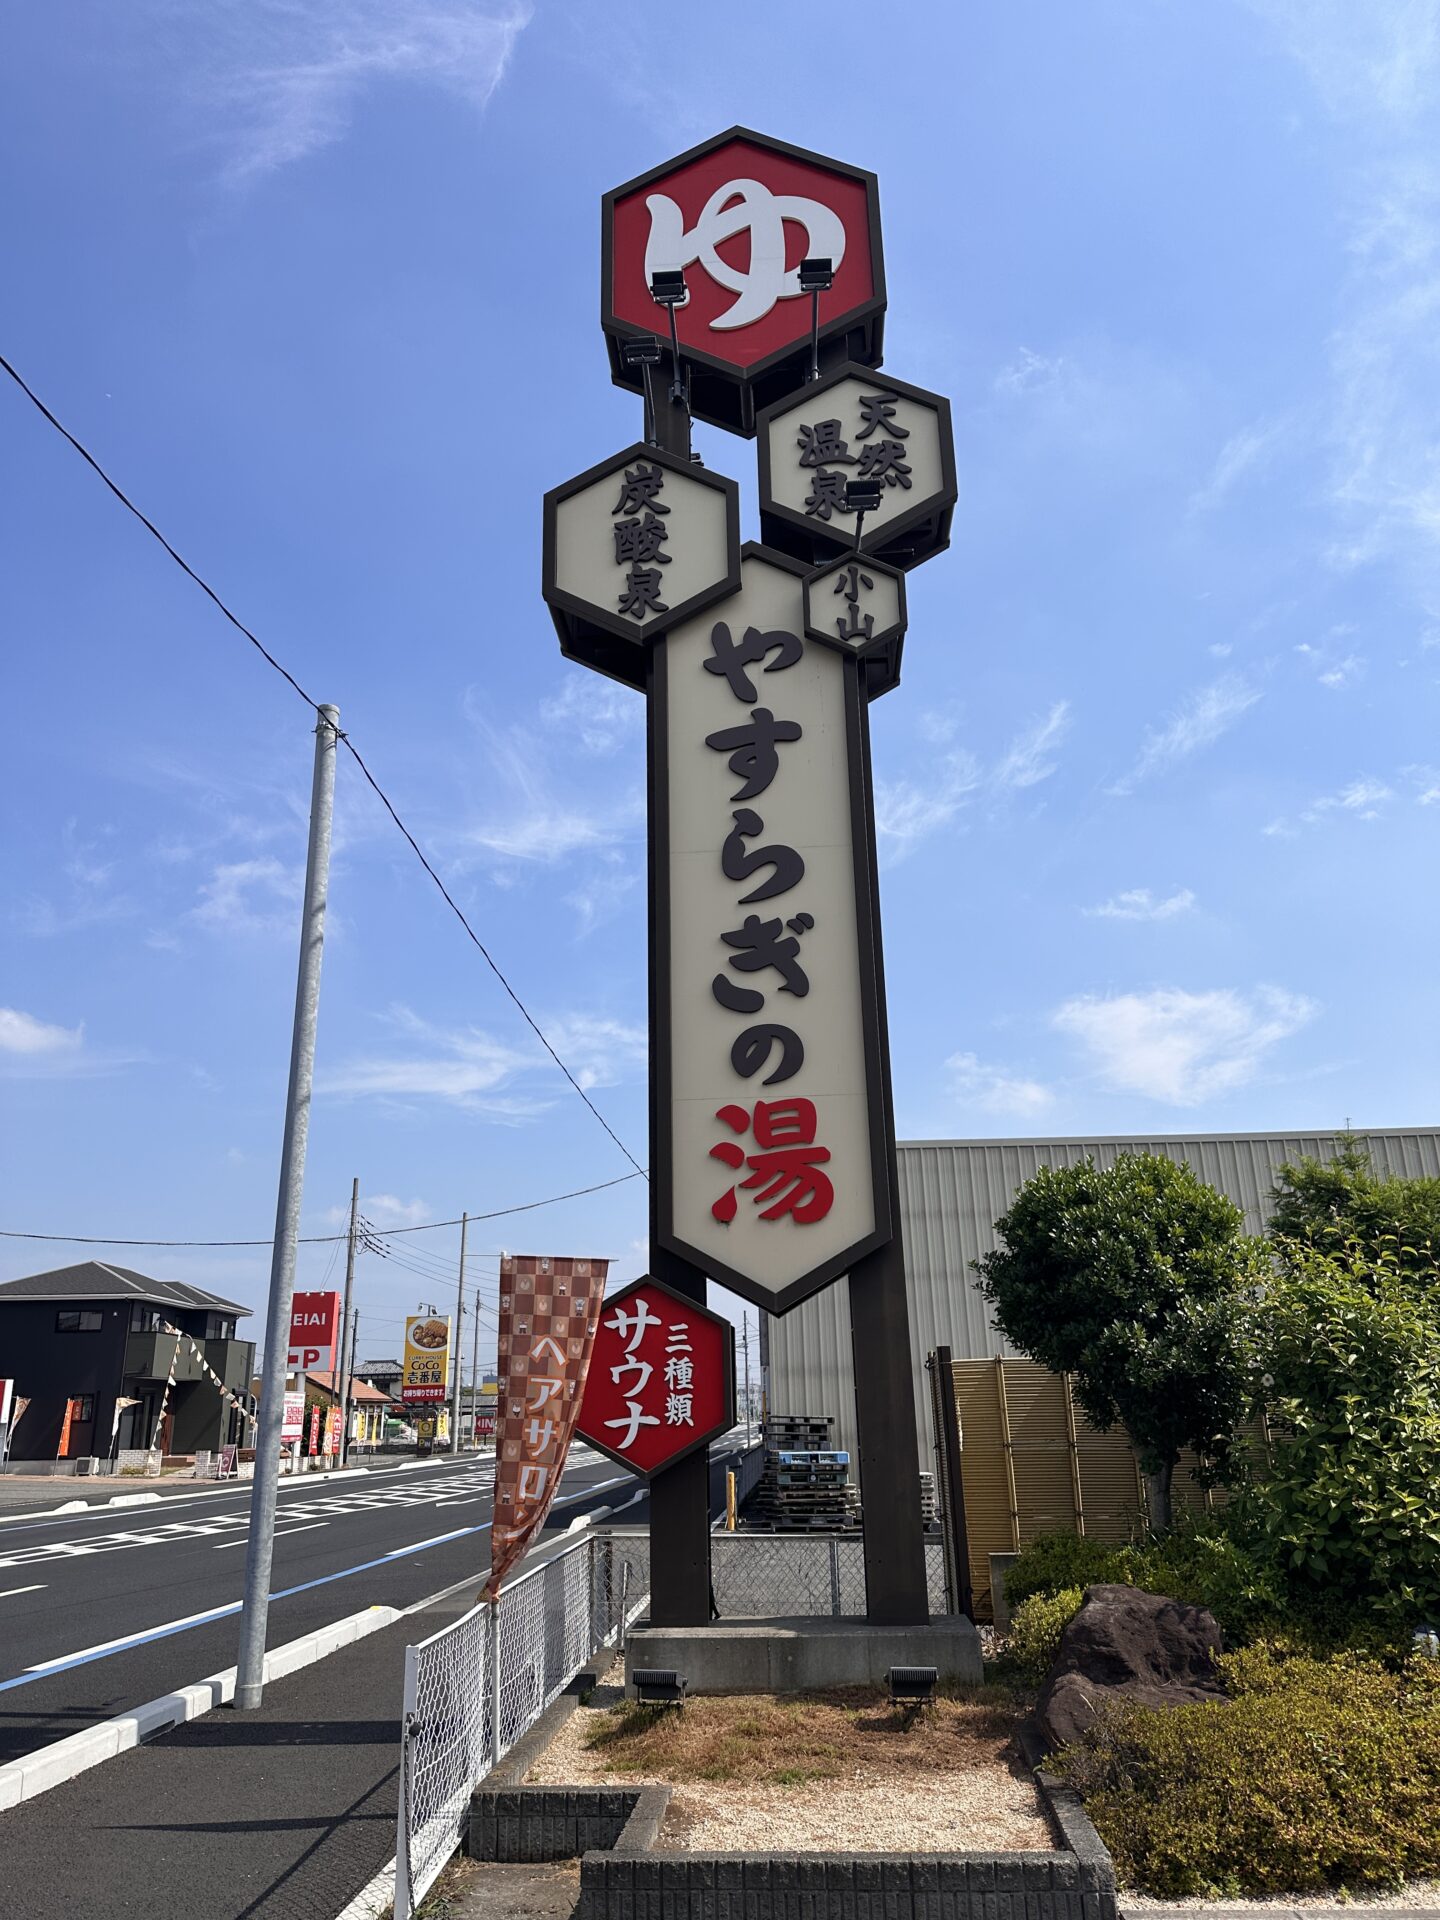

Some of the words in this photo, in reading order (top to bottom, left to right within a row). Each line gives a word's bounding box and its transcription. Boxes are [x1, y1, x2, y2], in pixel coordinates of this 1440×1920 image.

[644, 178, 846, 331] ゆ
[797, 418, 857, 521] 温泉
[854, 392, 912, 490] 天然
[611, 463, 673, 619] 炭酸泉
[834, 566, 874, 642] 小山
[703, 621, 834, 1224] やすらぎの湯
[291, 1312, 326, 1326] EIAI
[303, 1349, 320, 1369] P
[411, 1361, 439, 1370] CoCo
[408, 1371, 442, 1384] 壱番屋
[603, 1298, 662, 1450] サウナ
[663, 1323, 695, 1427] 三種類
[333, 1413, 341, 1447] KEIAI
